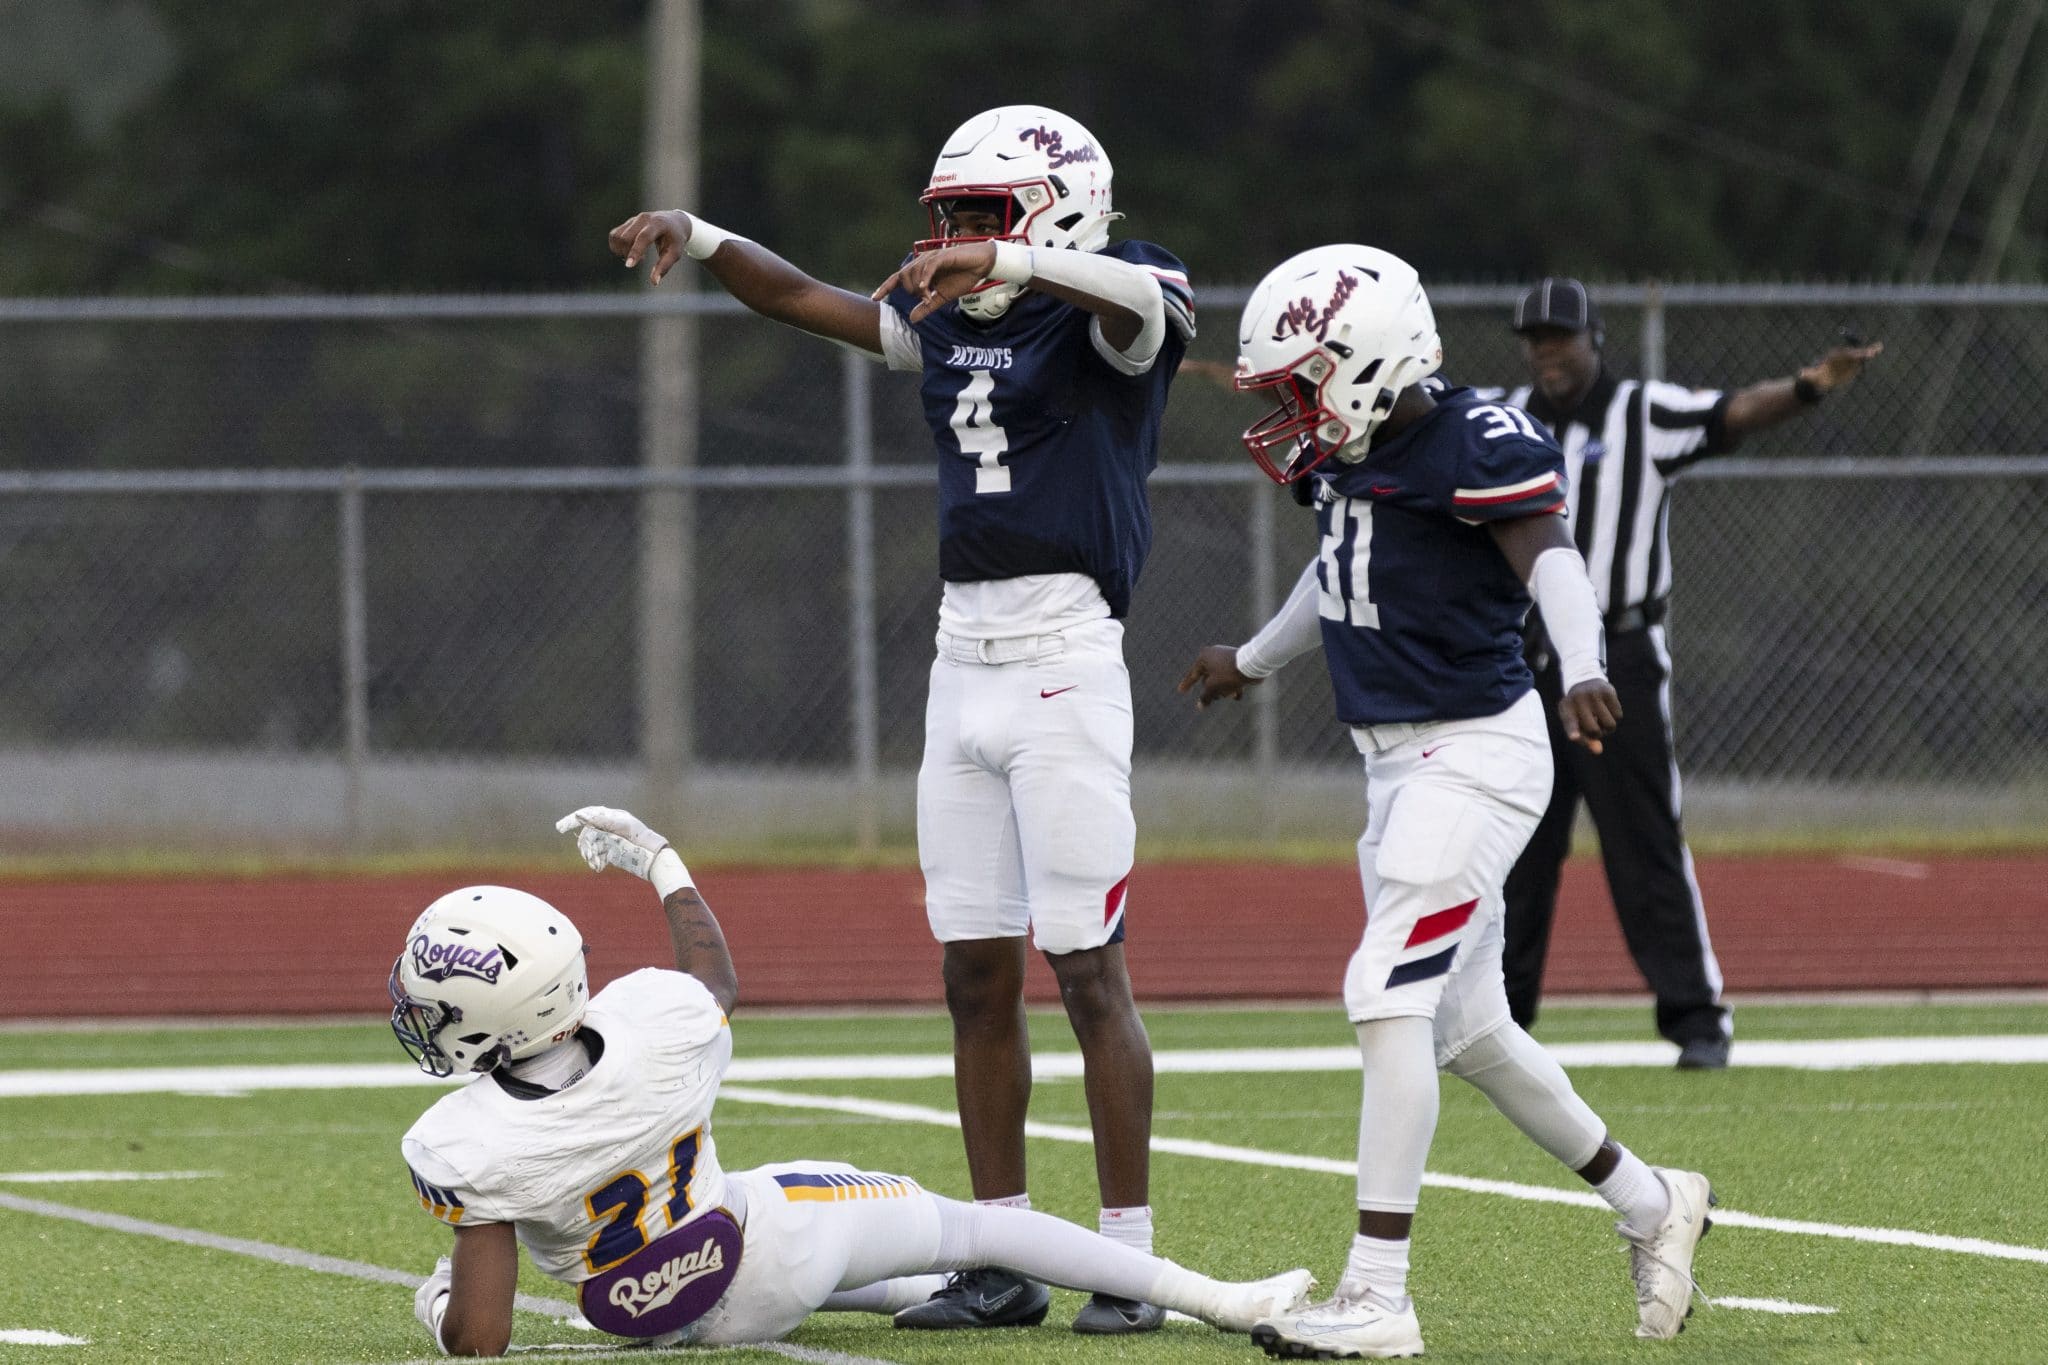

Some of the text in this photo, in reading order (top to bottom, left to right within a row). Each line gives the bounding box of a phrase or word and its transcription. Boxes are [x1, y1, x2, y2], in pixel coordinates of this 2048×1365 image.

[1019, 125, 1062, 151] The
[1046, 143, 1099, 170] South
[1276, 296, 1313, 336] The
[1306, 270, 1359, 343] South
[946, 345, 1013, 369] PATRIOTS
[949, 369, 1012, 493] 4
[1466, 404, 1545, 442] 31
[1313, 498, 1381, 630] 31
[411, 934, 504, 979] Royals
[608, 1237, 724, 1319] Royals
